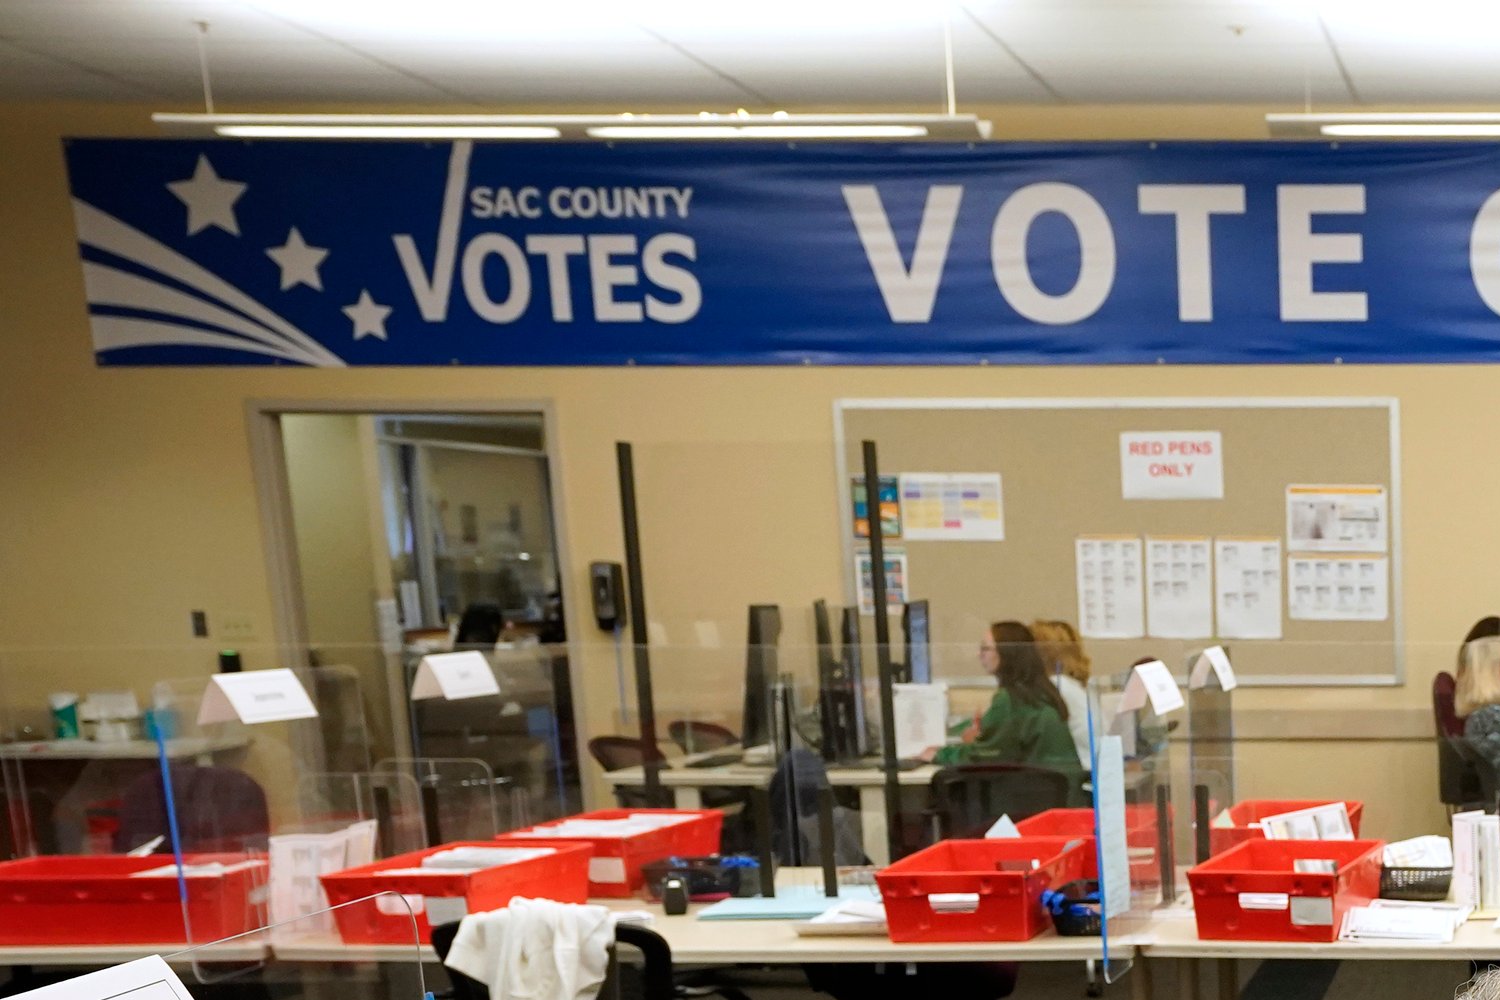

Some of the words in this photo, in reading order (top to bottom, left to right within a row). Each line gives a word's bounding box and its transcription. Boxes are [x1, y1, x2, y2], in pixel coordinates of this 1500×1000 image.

[470, 187, 541, 219] SAC
[548, 187, 692, 219] COUNTY
[393, 162, 703, 324] VOTES
[842, 181, 1369, 324] VOTE
[1129, 441, 1164, 456] RED
[1168, 440, 1213, 456] PENS
[1148, 463, 1194, 478] ONLY
